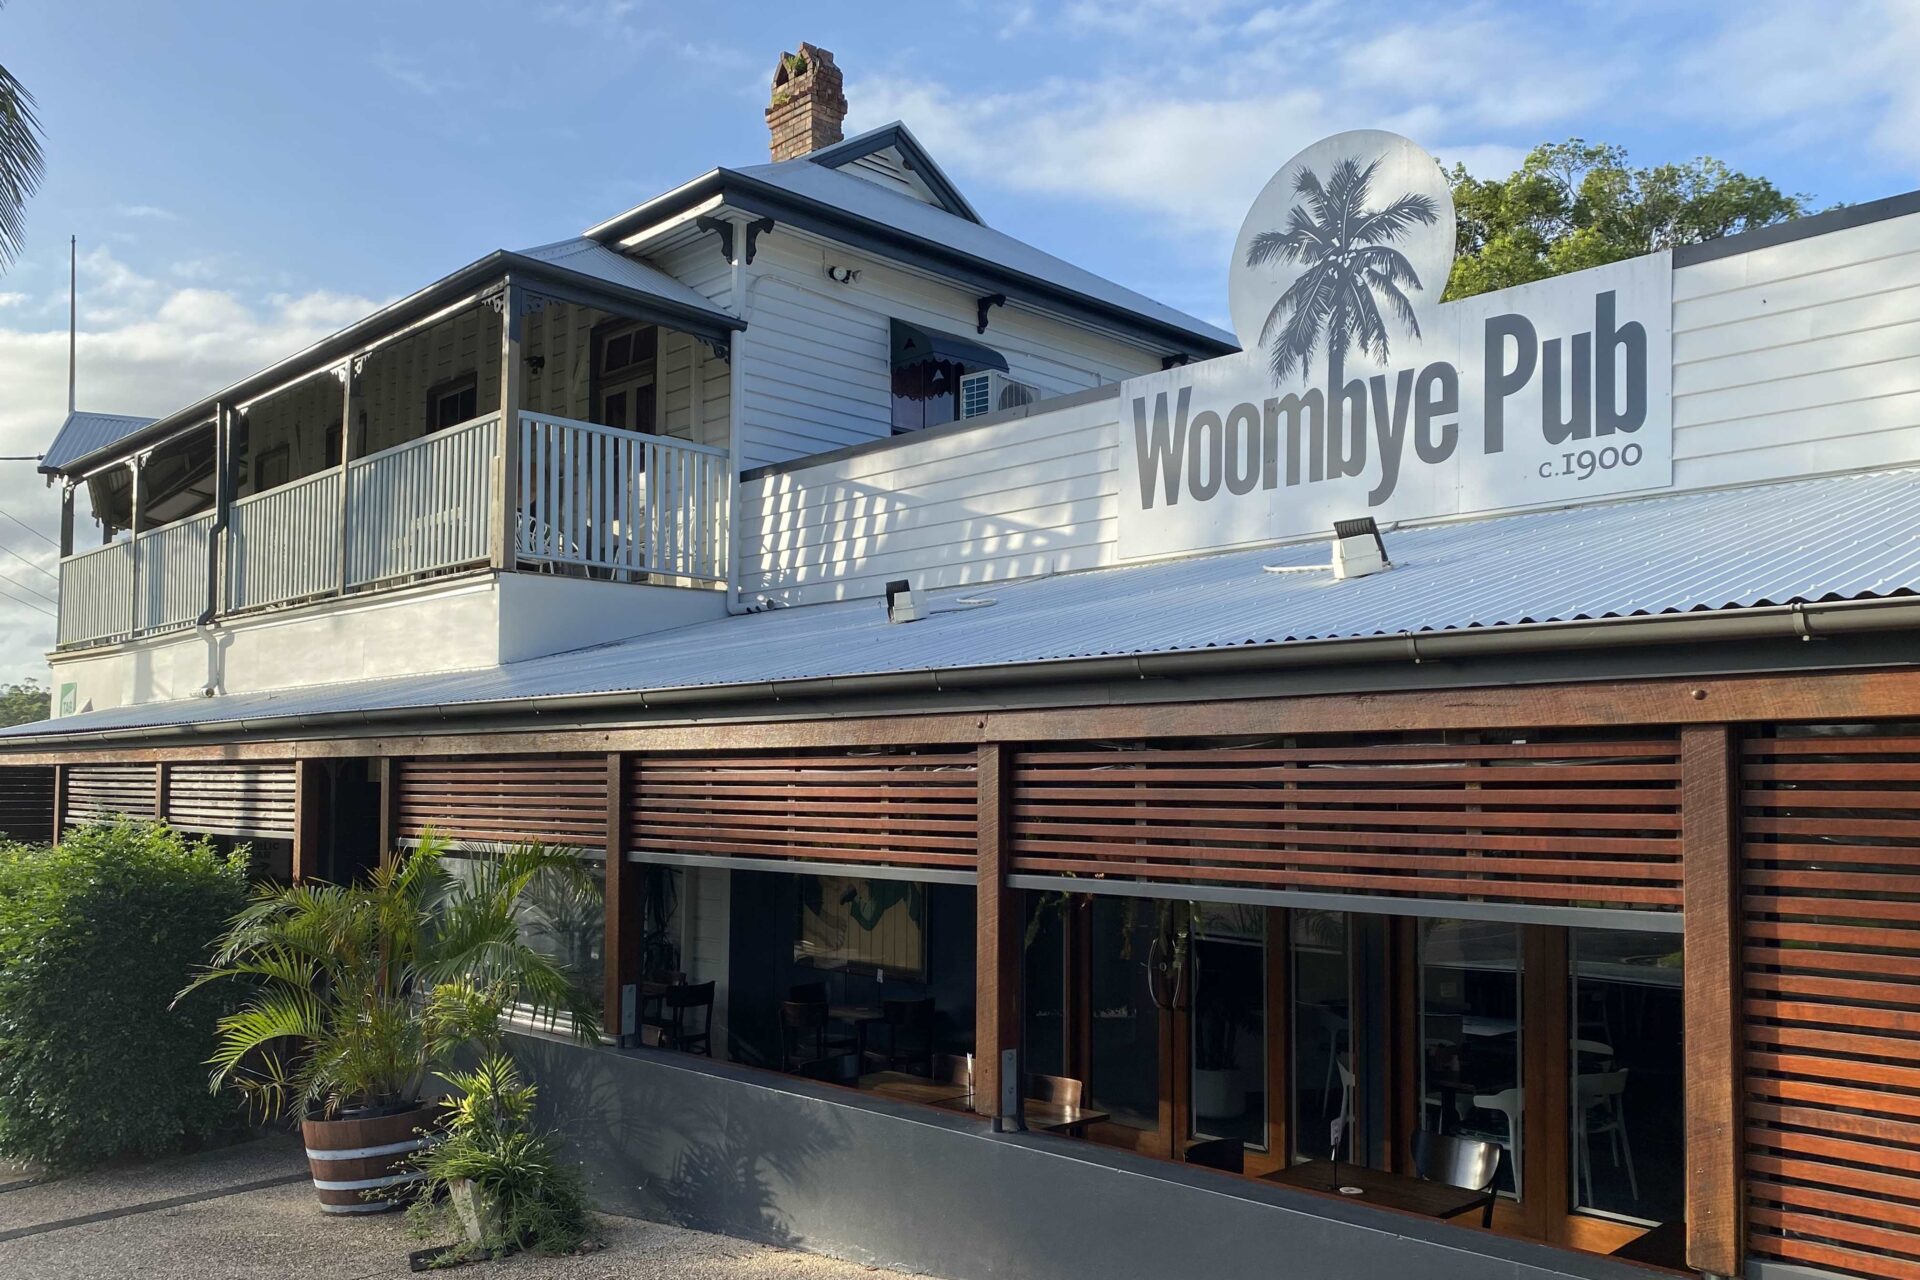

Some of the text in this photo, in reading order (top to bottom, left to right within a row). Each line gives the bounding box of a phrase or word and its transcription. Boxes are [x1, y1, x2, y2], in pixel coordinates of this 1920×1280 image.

[1132, 289, 1648, 510] Woombye Pub
[1538, 442, 1643, 481] c.1900
